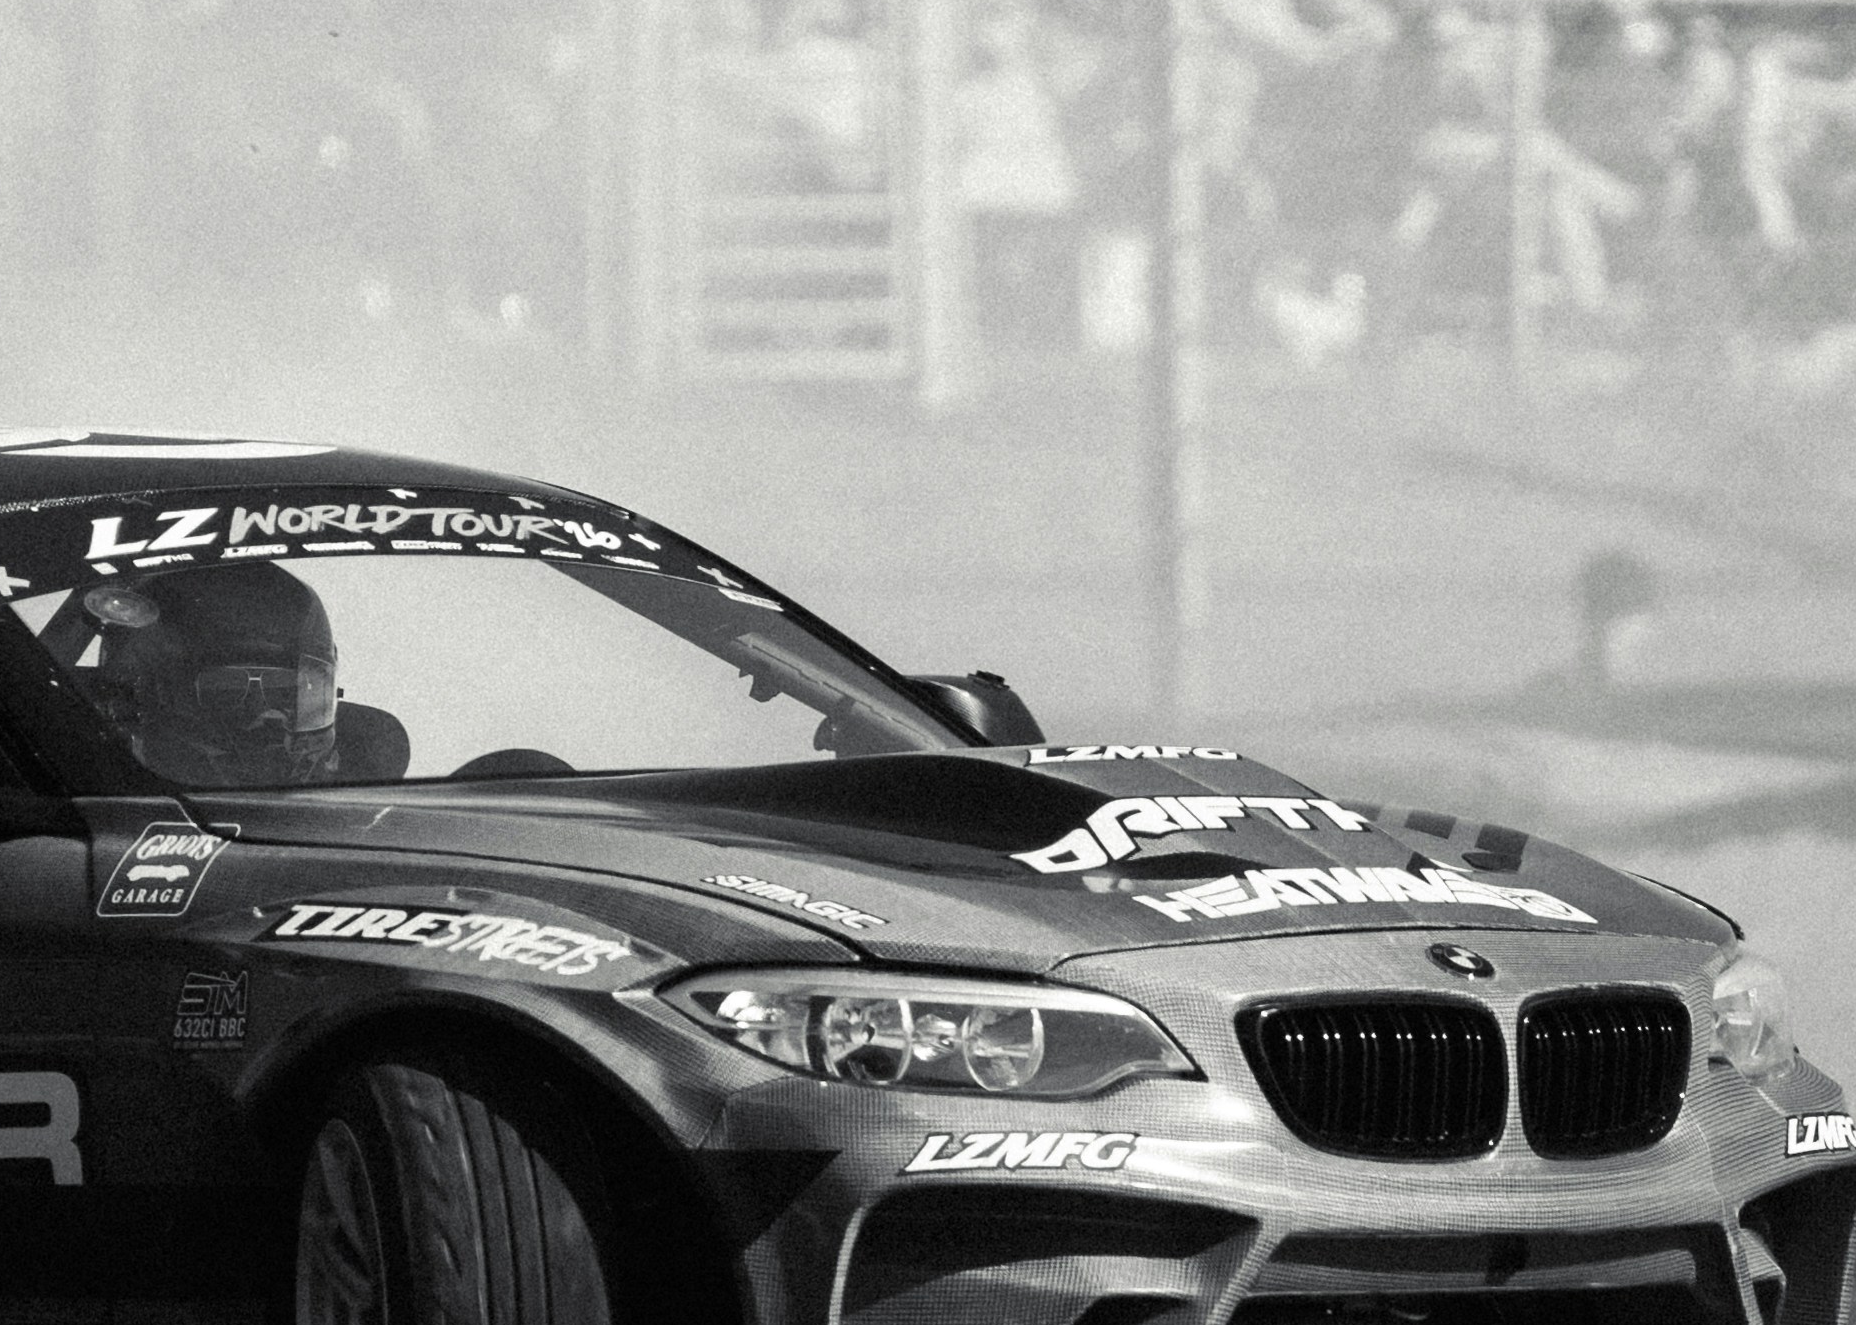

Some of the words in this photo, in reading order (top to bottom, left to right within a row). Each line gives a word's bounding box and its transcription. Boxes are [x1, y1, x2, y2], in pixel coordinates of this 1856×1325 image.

[85, 507, 219, 560] LZ
[228, 503, 407, 544] WORLD
[403, 508, 569, 545] TOUR
[1029, 745, 1238, 764] LZMFG
[111, 888, 185, 903] GARAGE
[173, 1018, 216, 1038] 632CI
[218, 1017, 246, 1038] BBC
[905, 1131, 1137, 1172] LZMFG
